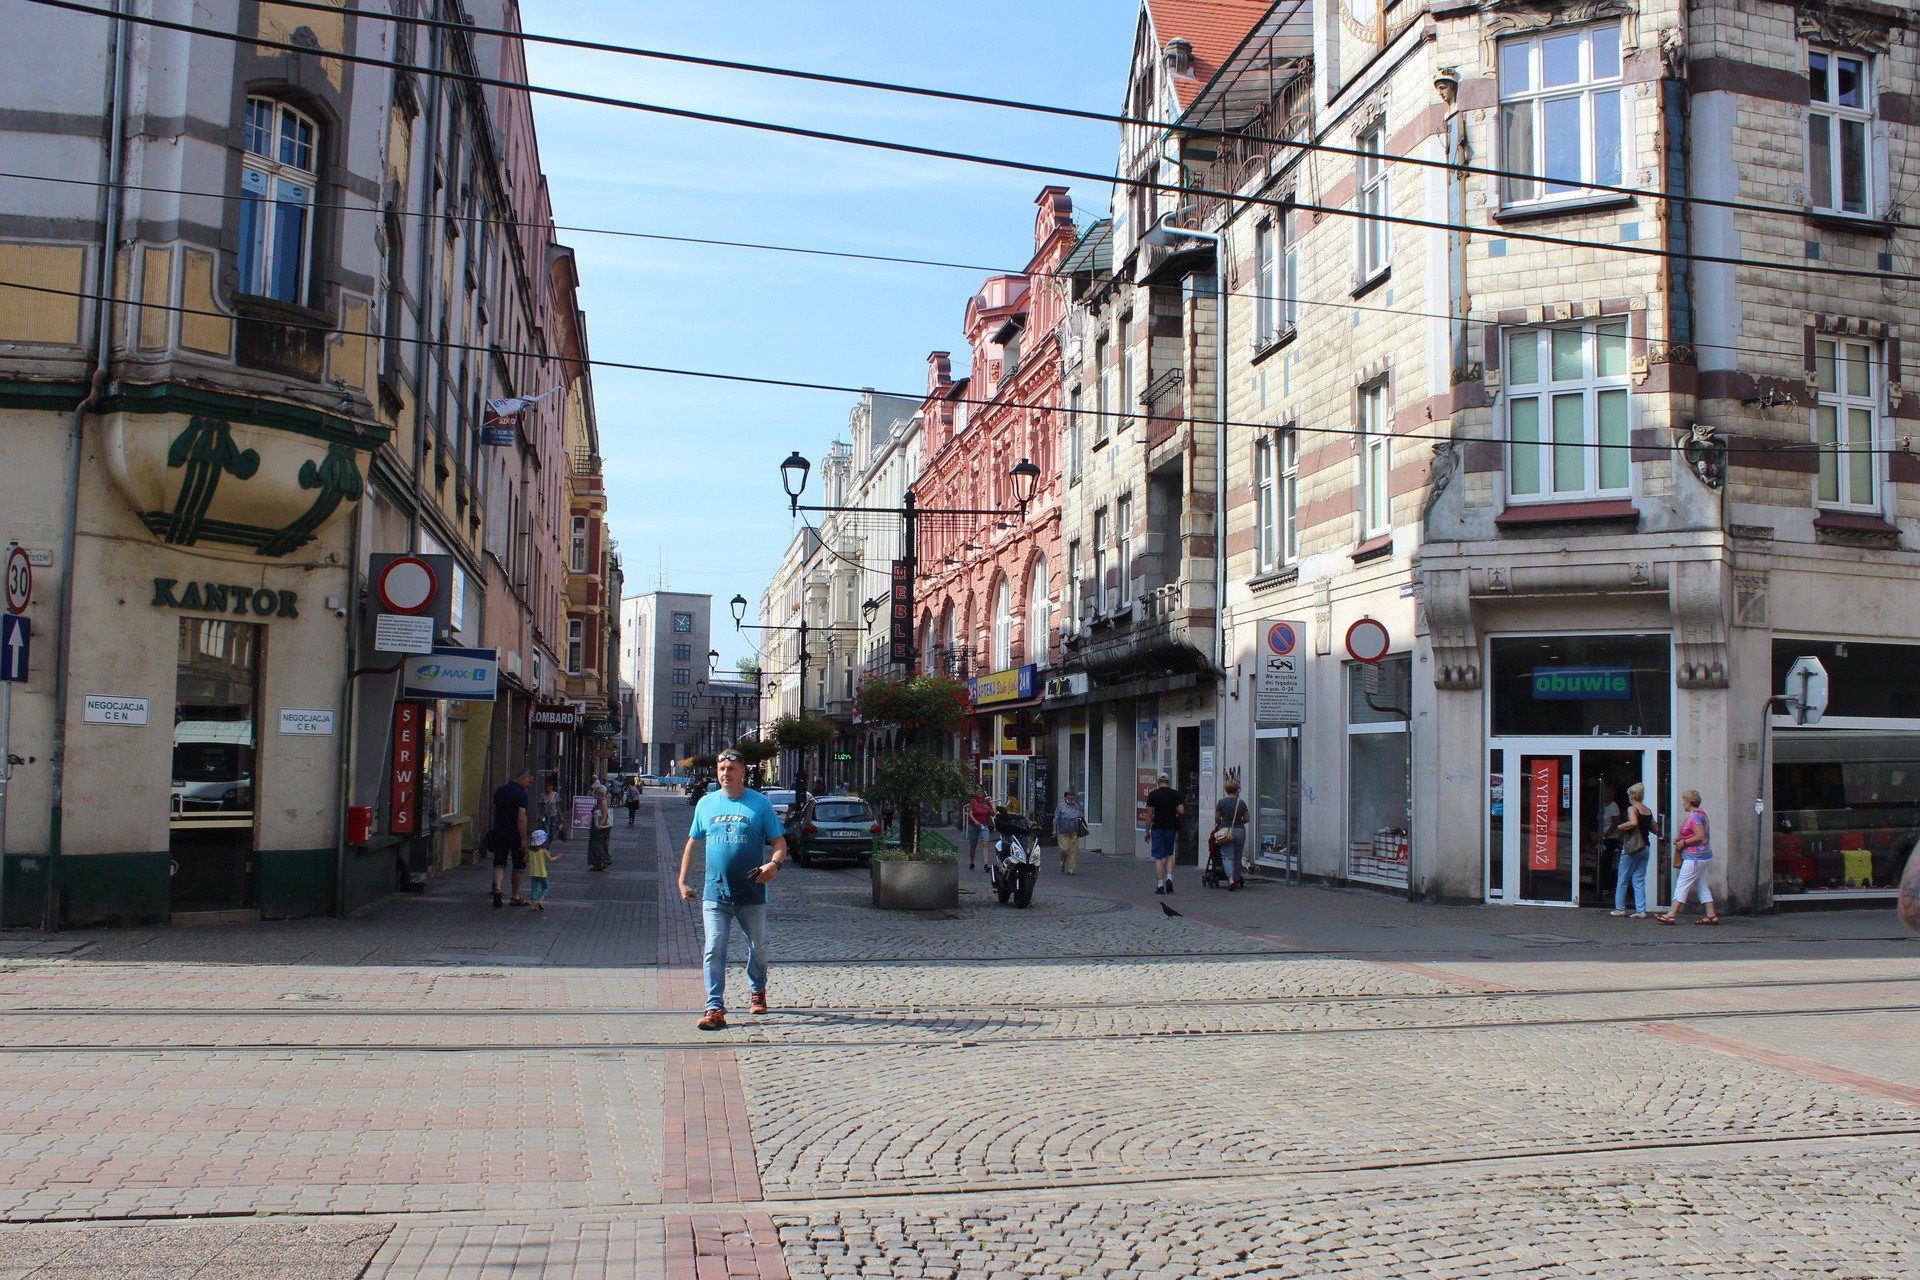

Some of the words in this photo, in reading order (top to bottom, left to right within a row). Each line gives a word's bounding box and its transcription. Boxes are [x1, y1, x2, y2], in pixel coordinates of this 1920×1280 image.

[10, 564, 28, 598] 30
[152, 577, 299, 619] KANTOR
[893, 565, 907, 658] MEBLE
[1536, 672, 1627, 692] obuwie
[88, 700, 145, 712] NEGOCJACJA
[105, 711, 128, 721] CEN
[283, 713, 331, 723] NEGOCJACJA
[297, 723, 317, 731] CEN
[397, 709, 412, 823] SERWIS
[714, 814, 744, 823] ENJOY
[1535, 766, 1550, 865] WYPRZEDAŻ
